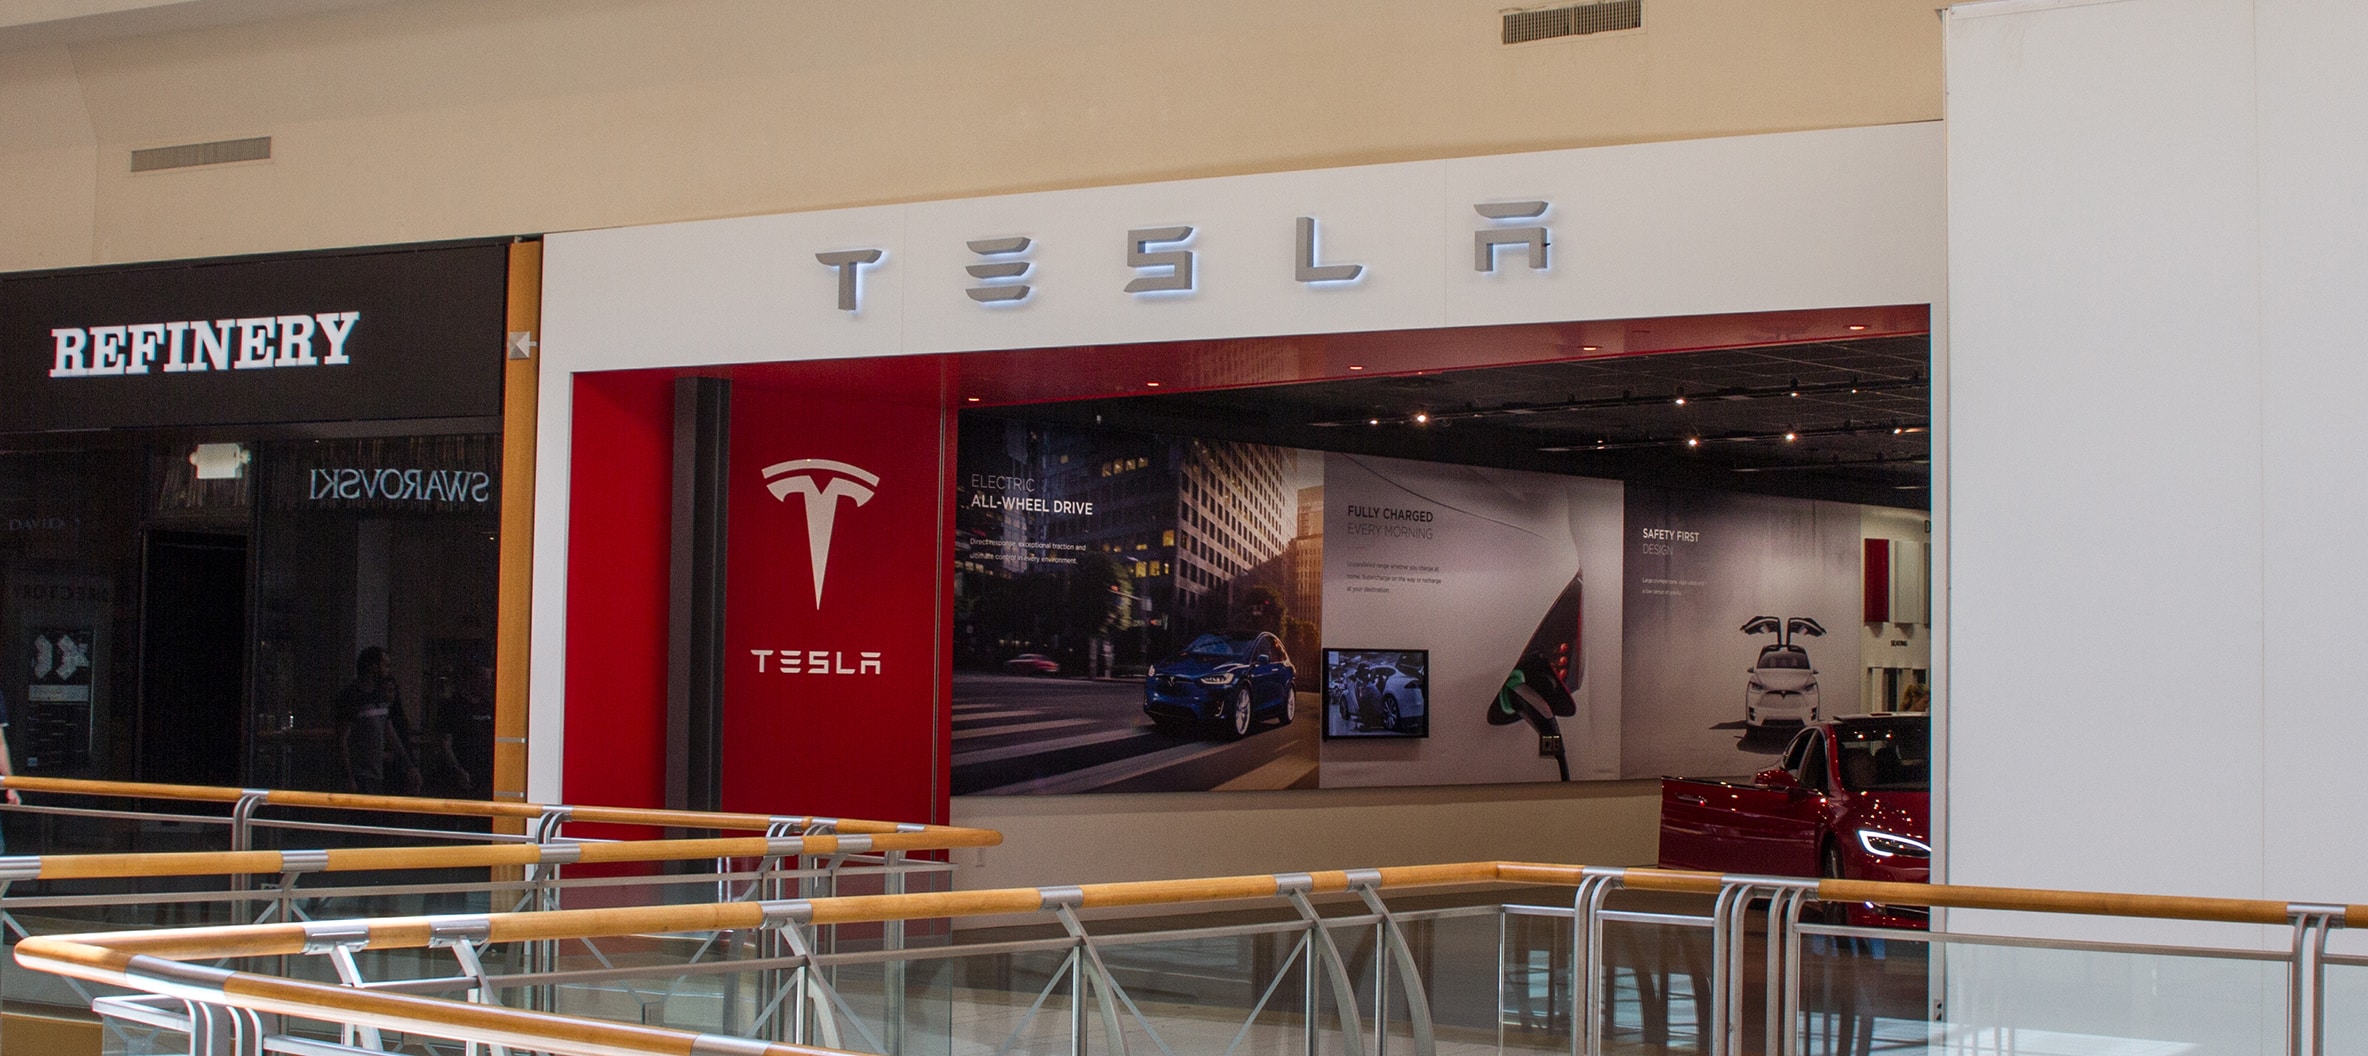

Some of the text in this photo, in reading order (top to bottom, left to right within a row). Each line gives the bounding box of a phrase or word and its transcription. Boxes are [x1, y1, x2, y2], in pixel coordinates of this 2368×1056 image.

[815, 200, 1552, 312] TESLA
[49, 311, 361, 378] REFINERY
[971, 473, 1036, 492] ELECTRIC
[971, 494, 1094, 516] ALL-WHEEL DRIVE
[1347, 505, 1434, 522] FULLY CHARGED
[1347, 522, 1434, 541] EVERY MORNING
[1643, 528, 1700, 543] SAFETY FIRST
[1052, 543, 1074, 551] traction
[1643, 543, 1674, 555] DESIGN
[750, 649, 881, 675] TESLA
